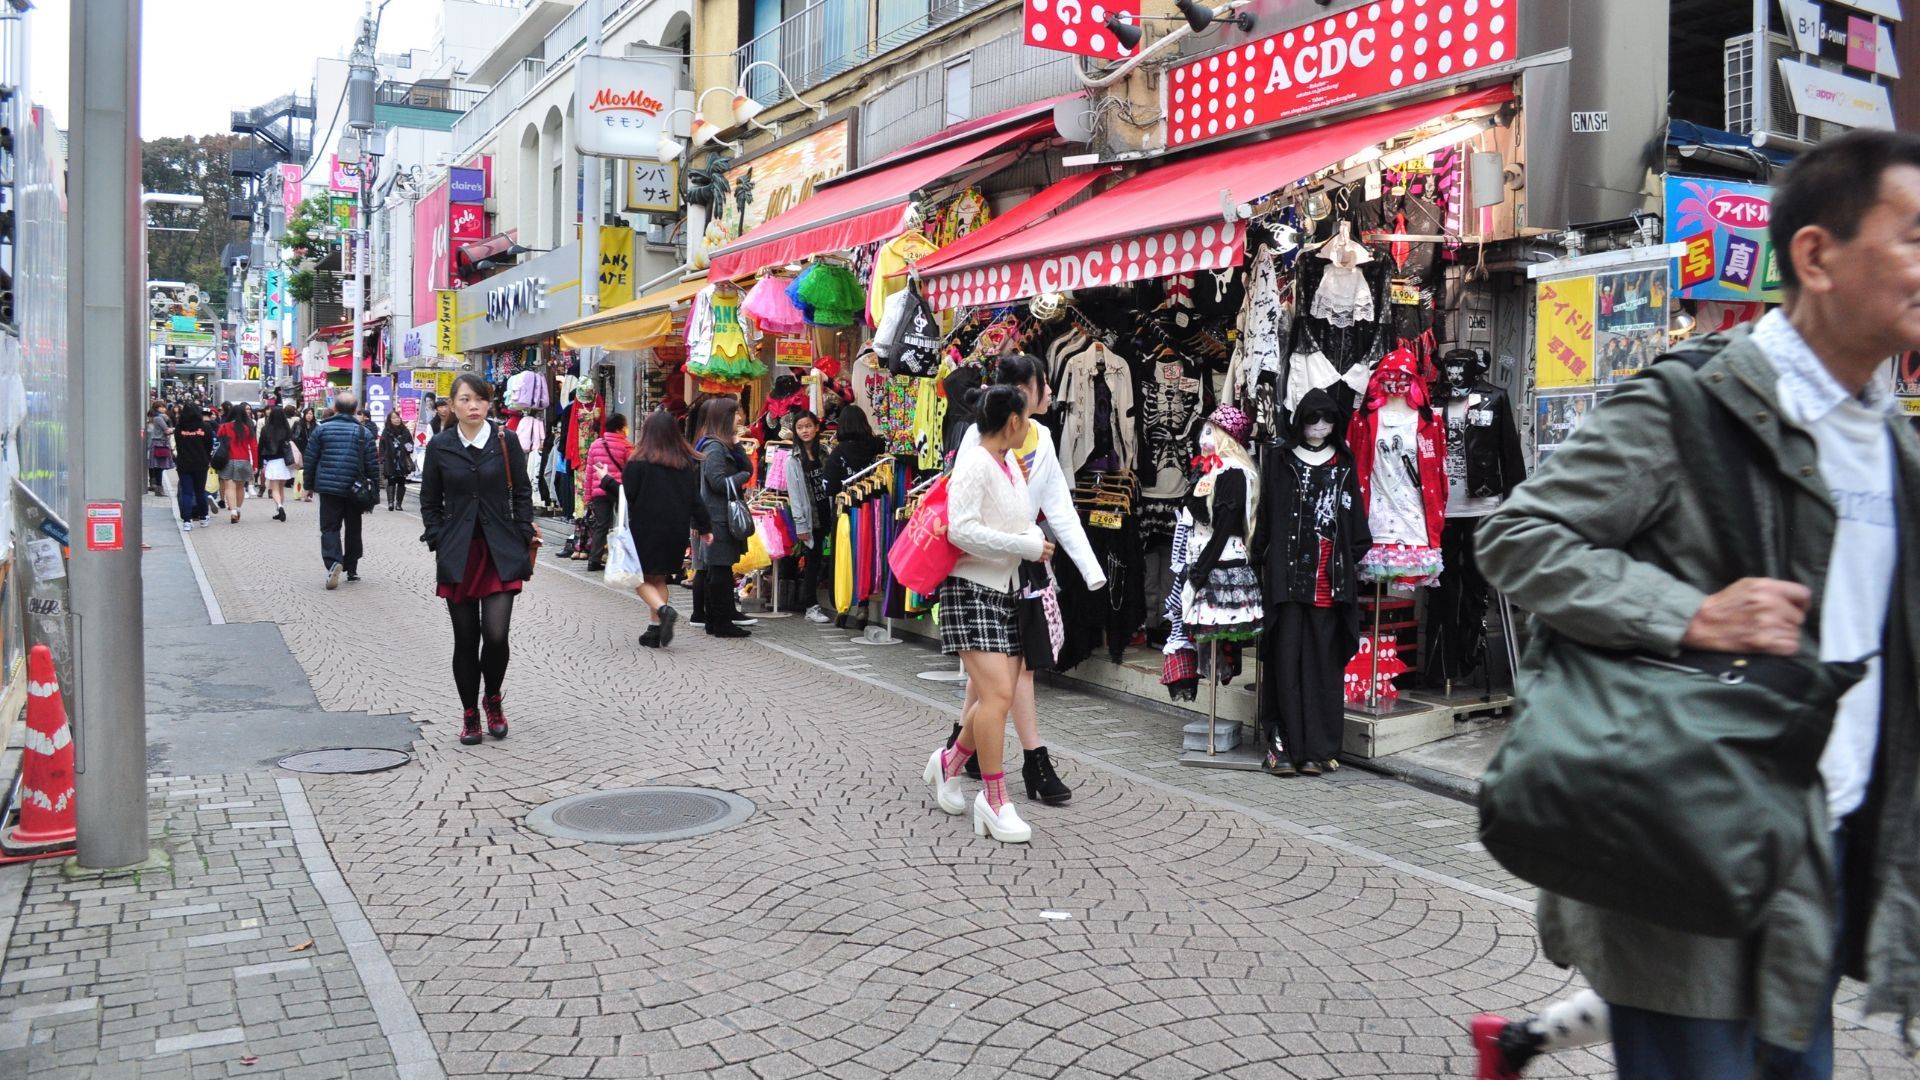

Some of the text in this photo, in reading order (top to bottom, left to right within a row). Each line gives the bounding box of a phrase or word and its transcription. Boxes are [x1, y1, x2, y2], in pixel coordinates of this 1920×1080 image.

[1263, 27, 1376, 95] ACDC
[605, 116, 645, 128] モモン
[287, 171, 296, 223] DAIS
[451, 181, 482, 192] claire's
[635, 166, 665, 181] シバ
[643, 187, 671, 203] サキ
[1019, 250, 1103, 299] ACDC
[442, 294, 451, 351] JEANS MATE
[1540, 286, 1593, 341] アイドル
